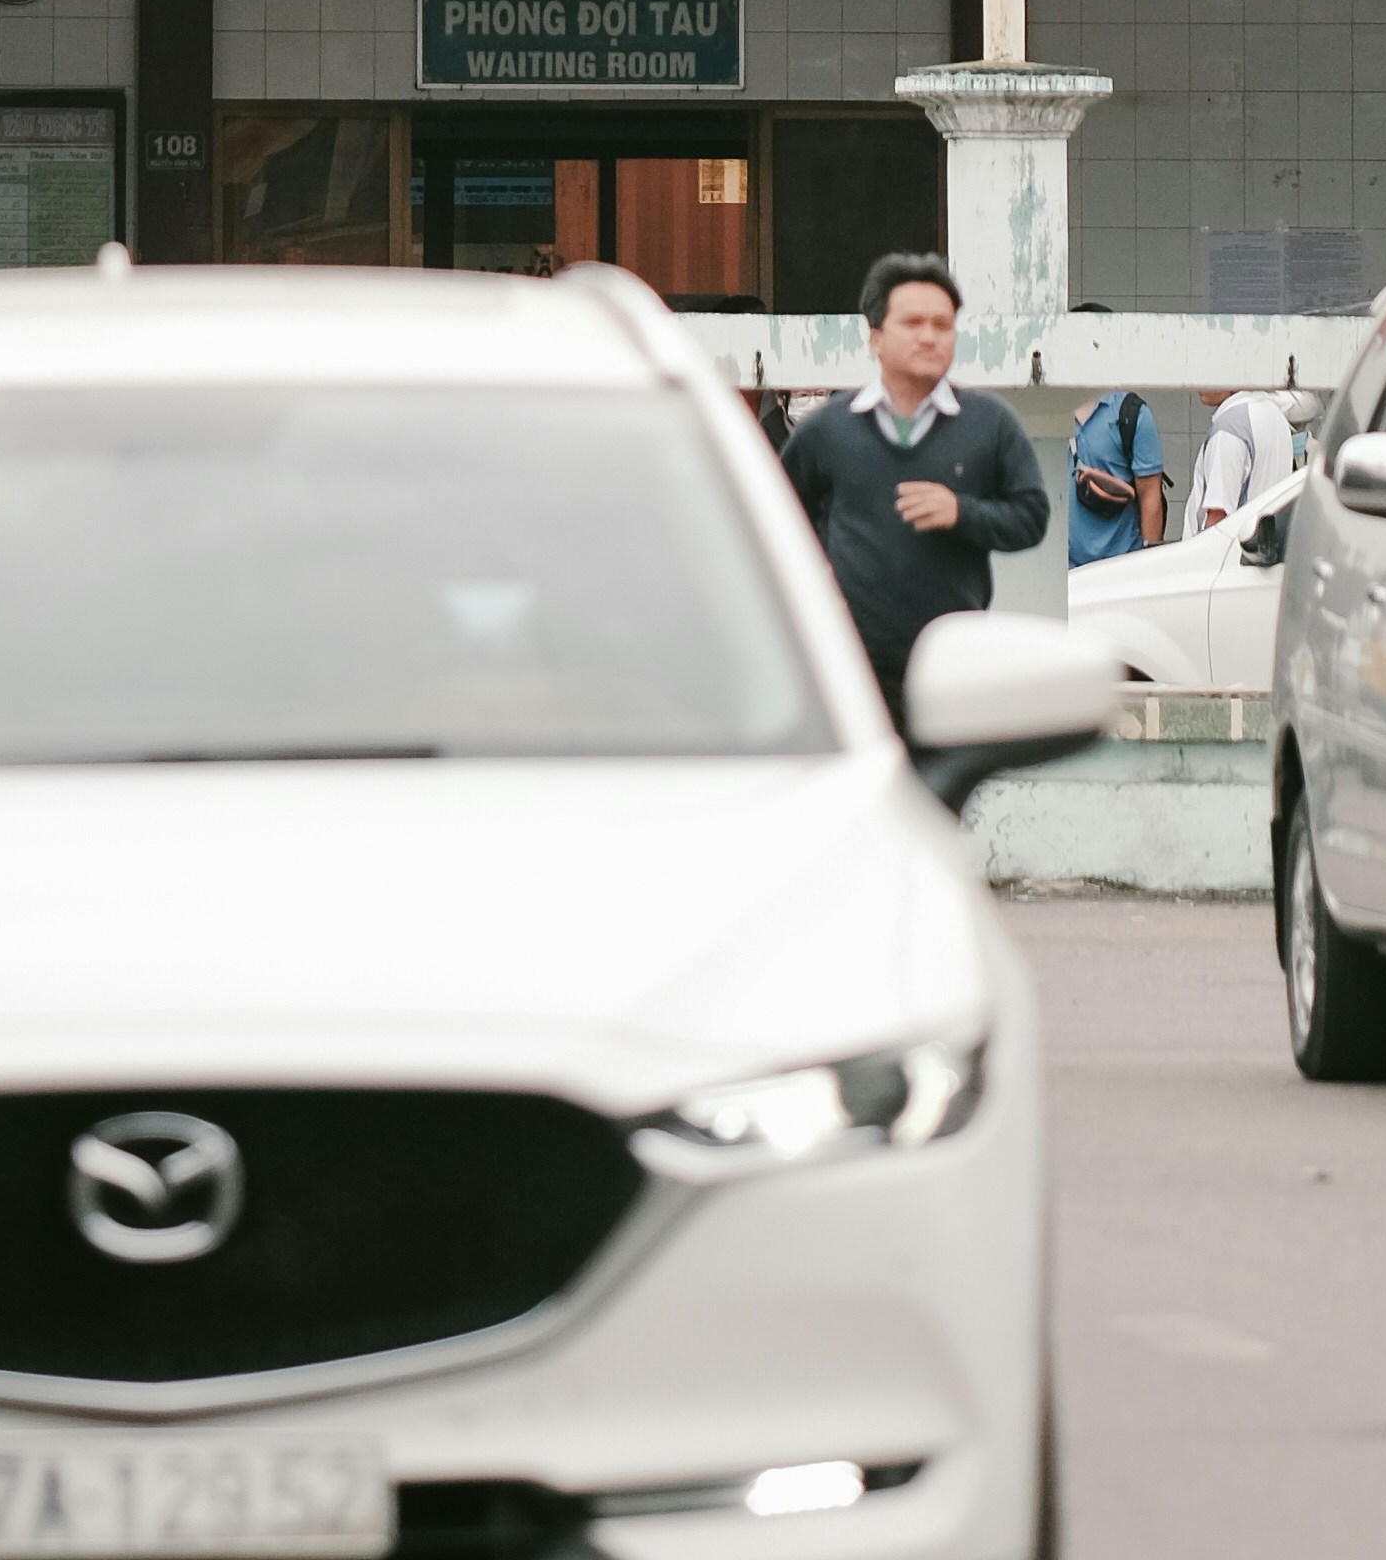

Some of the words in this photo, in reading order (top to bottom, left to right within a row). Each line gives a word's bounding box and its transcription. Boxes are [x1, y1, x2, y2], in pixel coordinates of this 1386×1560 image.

[465, 50, 597, 79] WAITING
[607, 50, 697, 79] ROOM
[153, 135, 197, 156] 108
